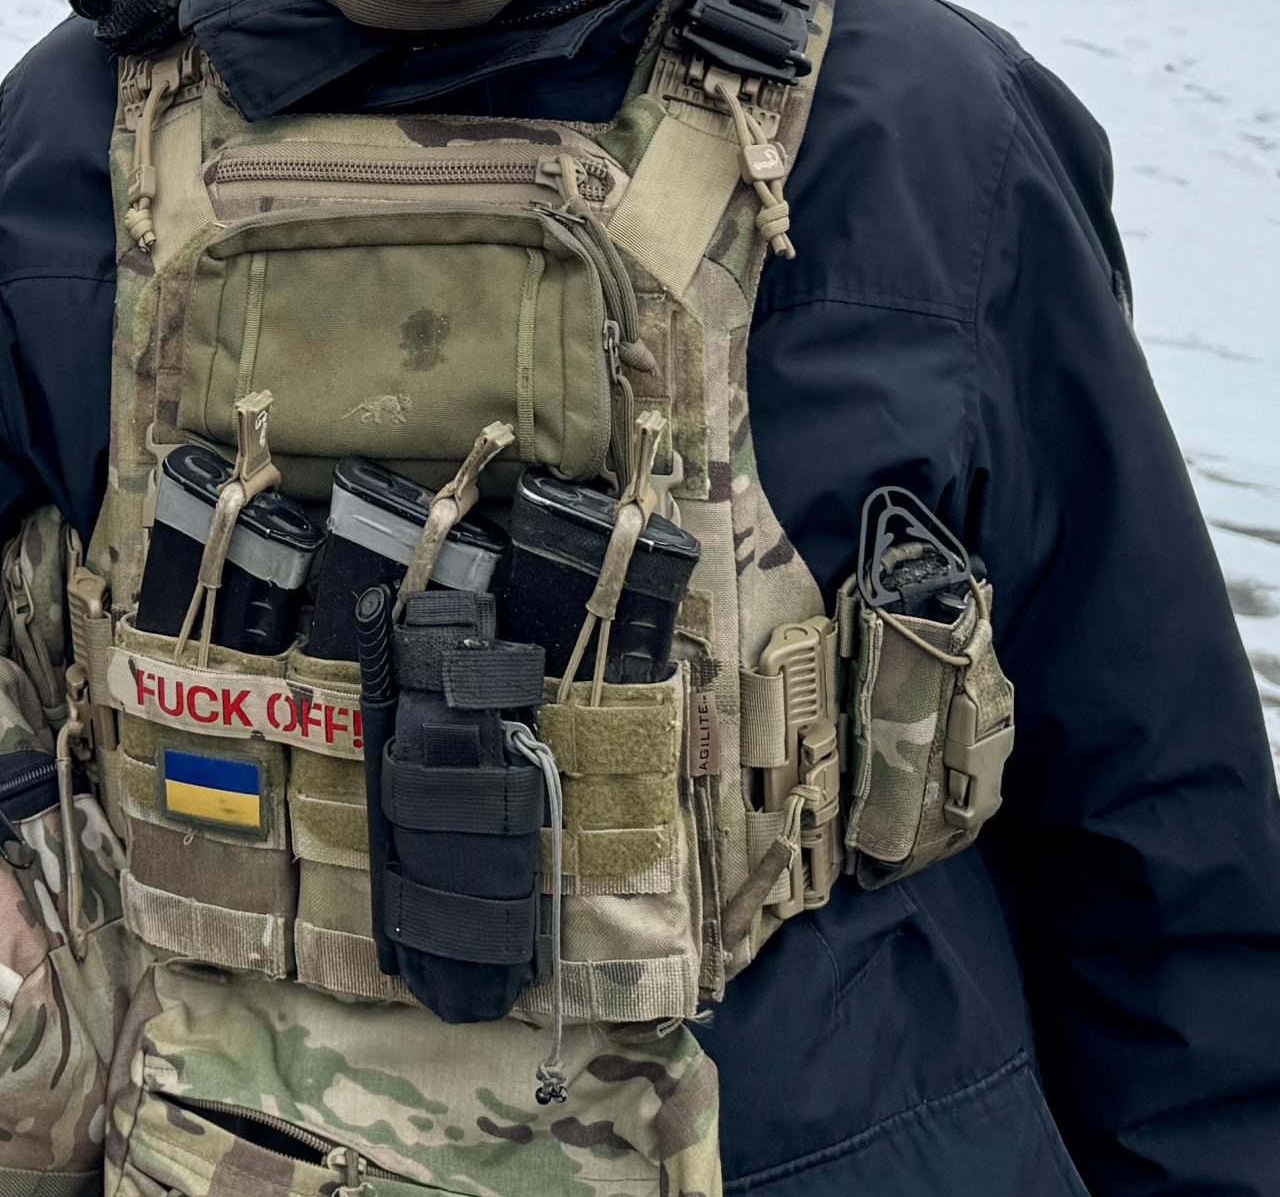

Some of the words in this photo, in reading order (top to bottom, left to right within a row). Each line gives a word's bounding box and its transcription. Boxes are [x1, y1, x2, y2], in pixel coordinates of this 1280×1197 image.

[136, 668, 253, 727] FUCK
[266, 692, 364, 749] OFF!
[698, 704, 710, 771] AGILITE
